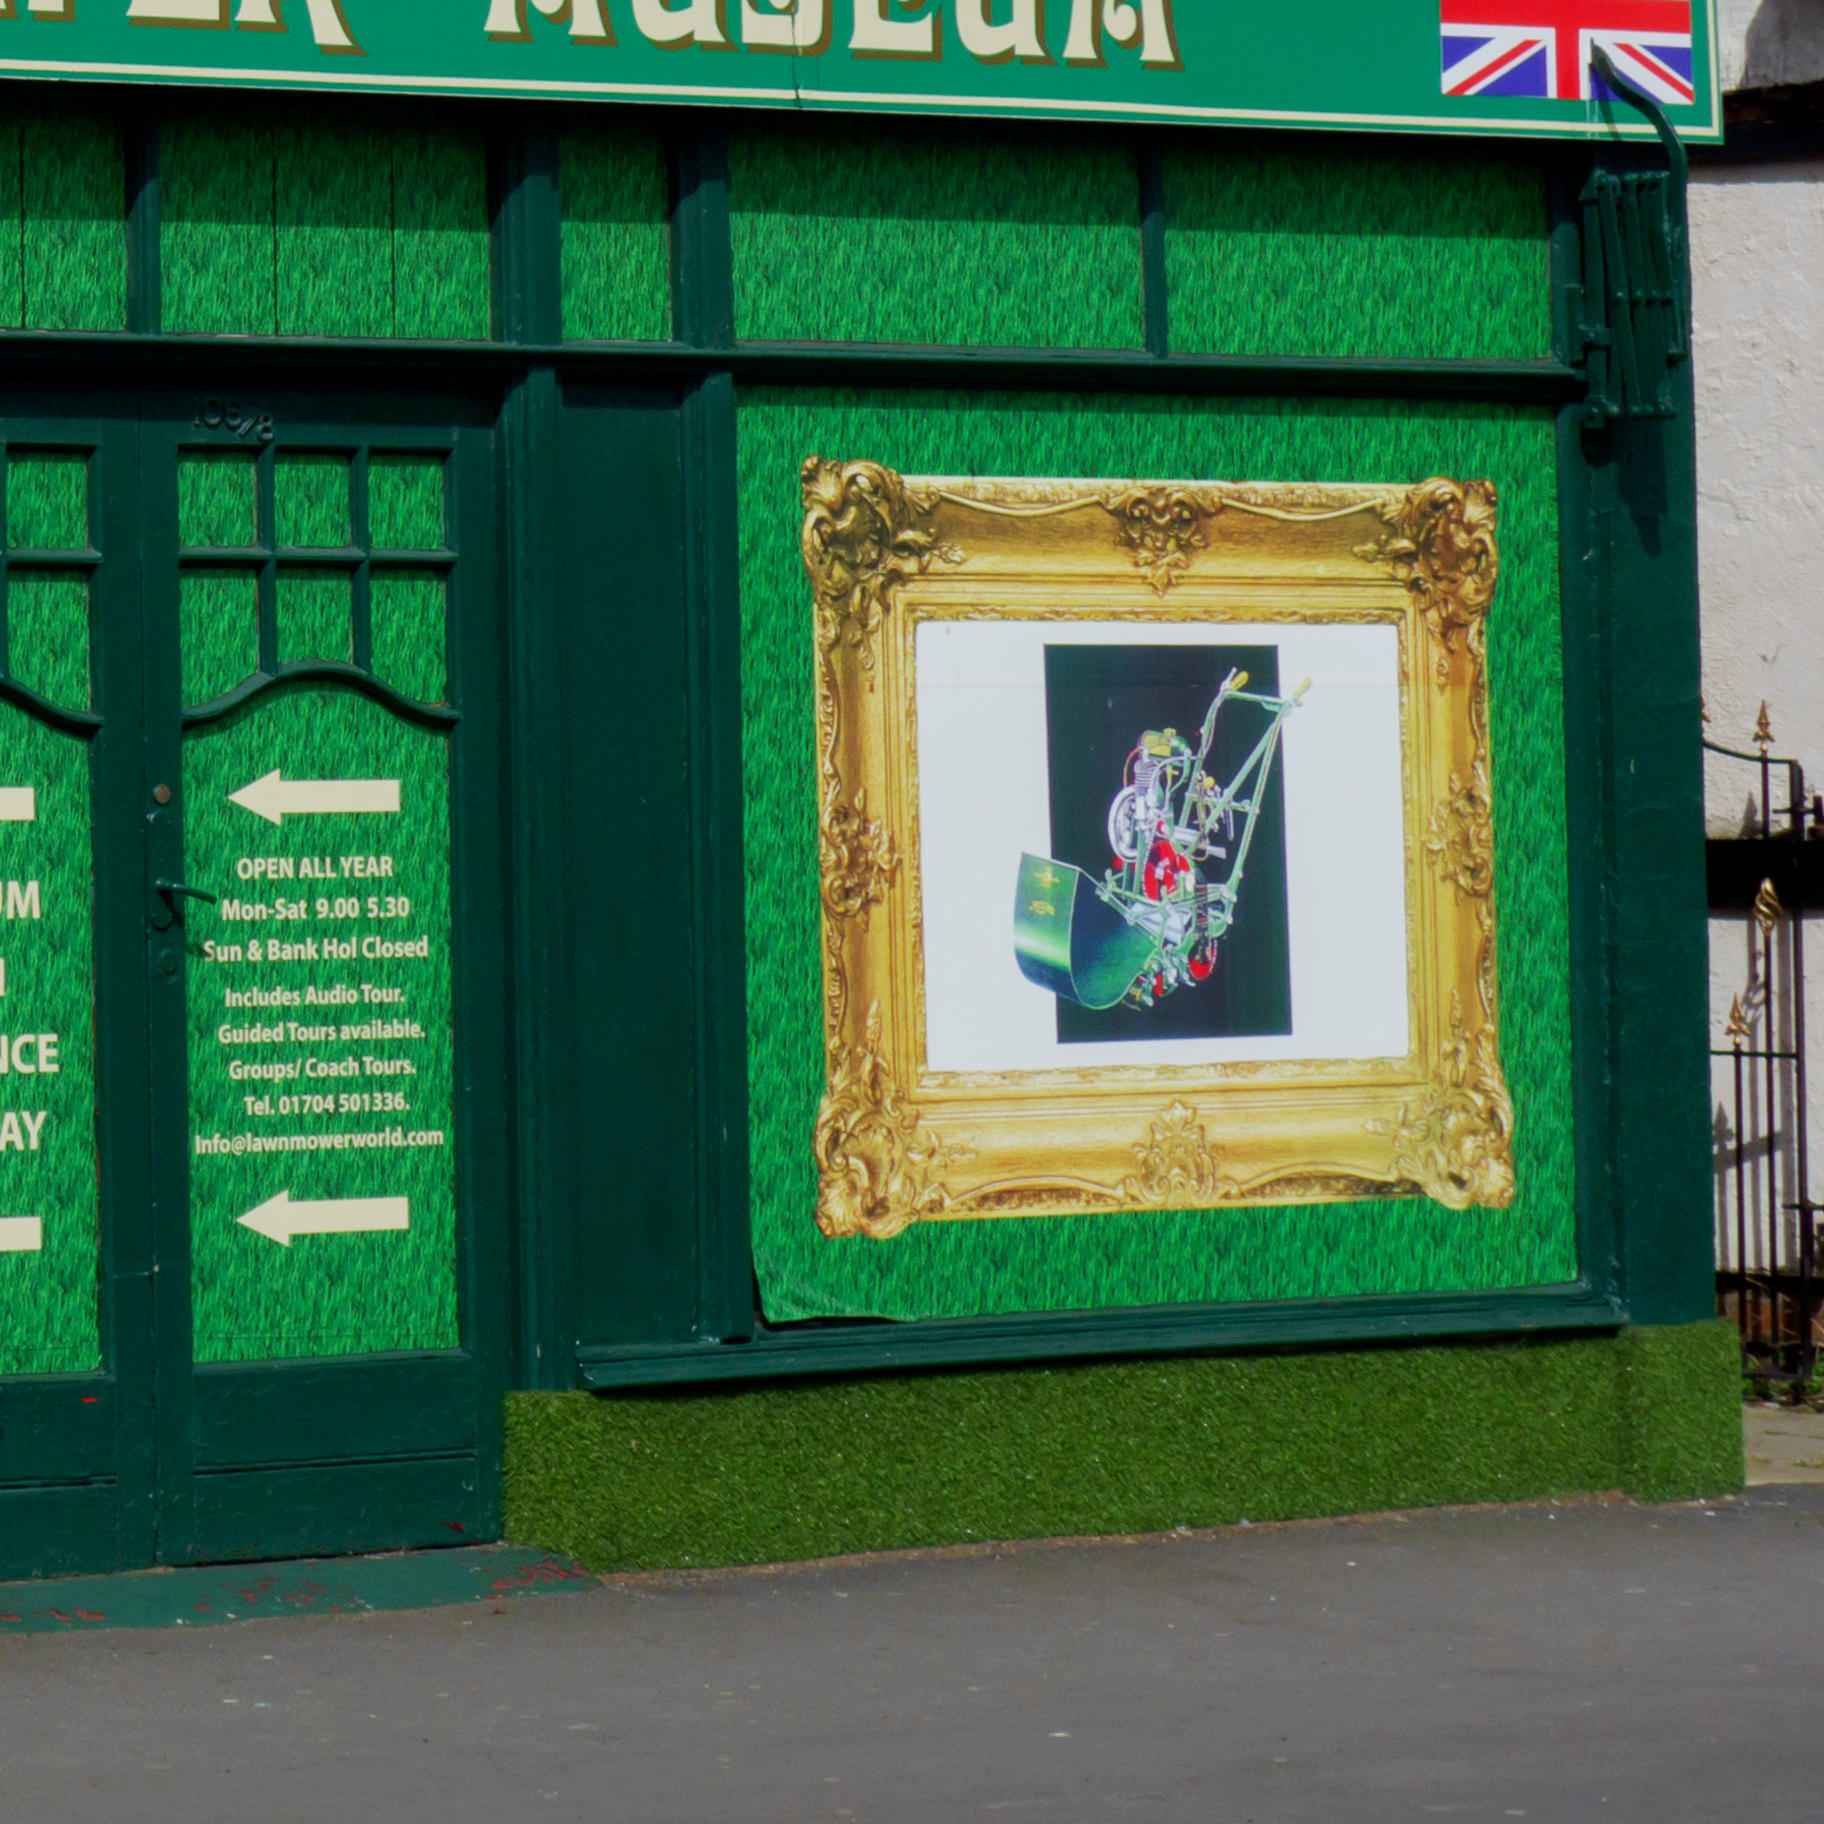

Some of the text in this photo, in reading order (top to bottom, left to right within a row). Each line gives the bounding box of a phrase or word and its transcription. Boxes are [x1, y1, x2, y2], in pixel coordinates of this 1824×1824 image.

[237, 856, 393, 879] OPEN ALL YEAR
[221, 896, 411, 921] Mon-Sat 9.00 5.30
[203, 935, 429, 962] Sun & Bank Hol Closed
[225, 984, 405, 1008] Includes Audio Tour.
[218, 1019, 426, 1045] Guided Tours available.
[229, 1056, 416, 1083] Groups/ Coach Tours.
[244, 1092, 410, 1116] Tel. 01704 501336.
[195, 1127, 444, 1155] Info@lawnmowerworld.com
